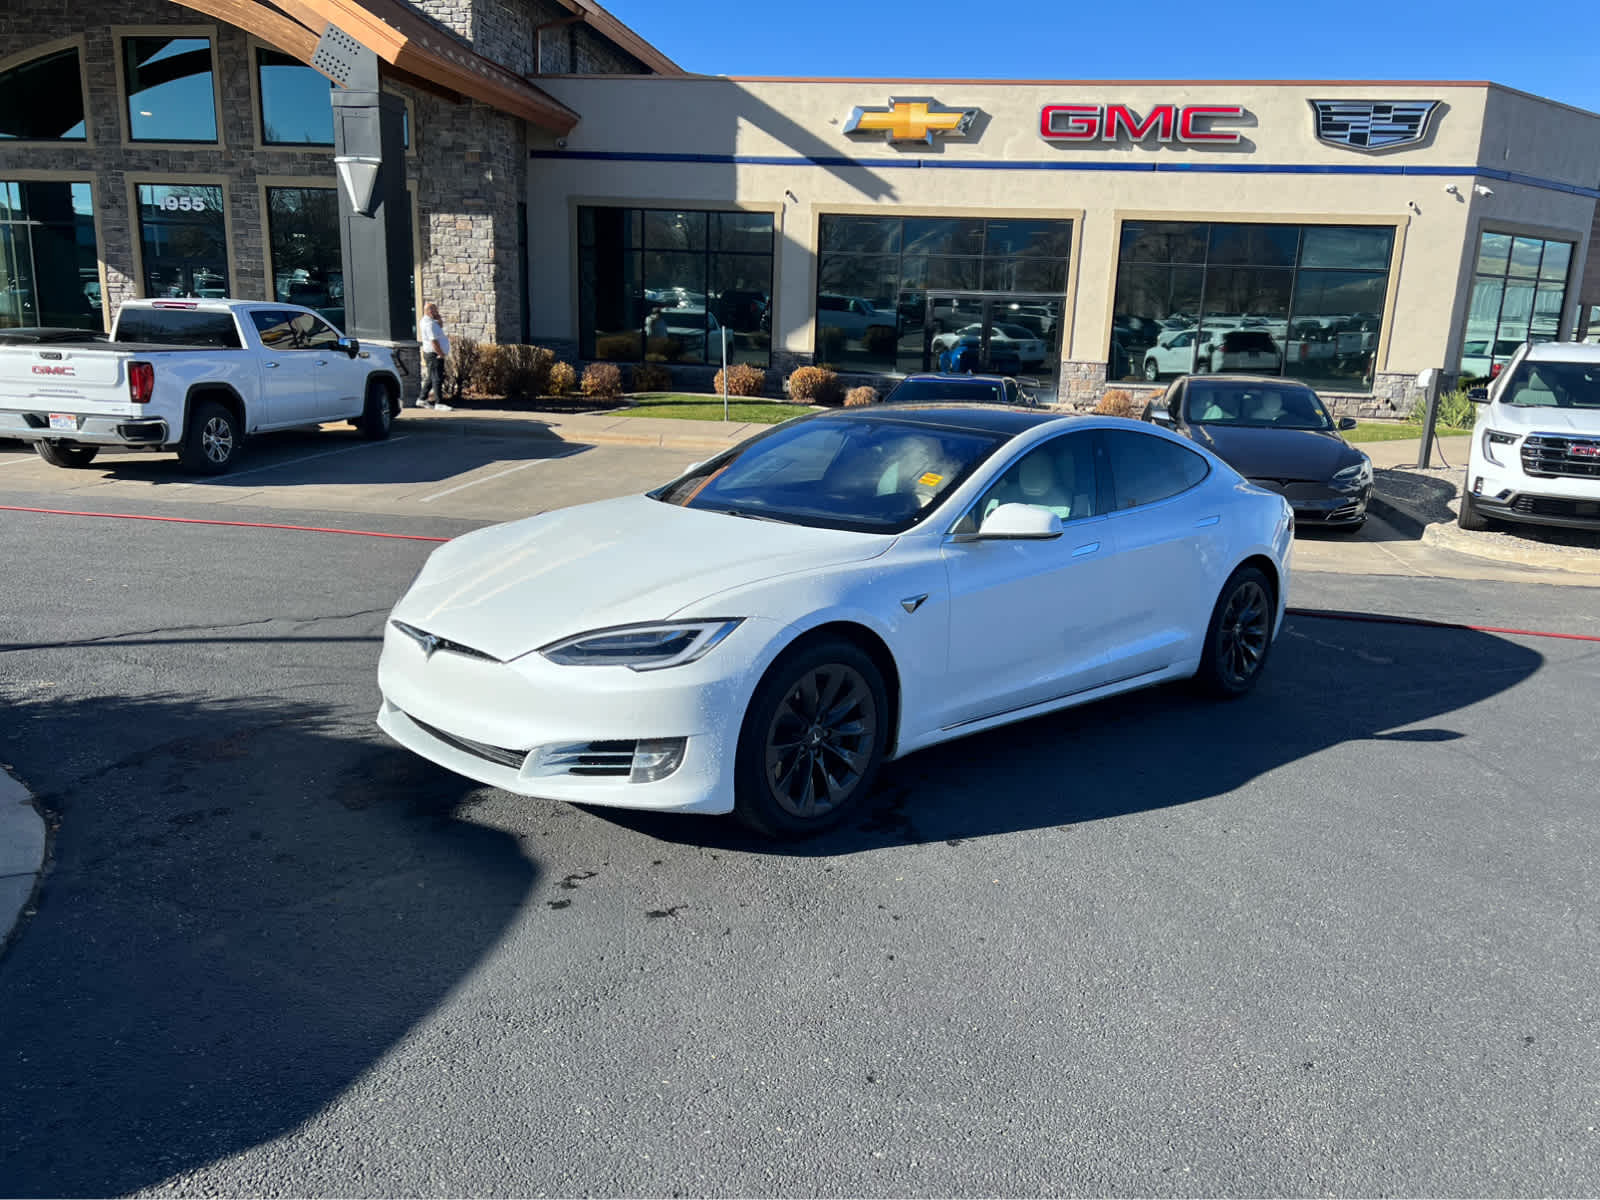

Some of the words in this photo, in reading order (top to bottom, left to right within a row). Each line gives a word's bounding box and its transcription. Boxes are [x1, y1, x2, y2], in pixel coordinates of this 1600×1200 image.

[1039, 104, 1243, 143] GMC
[160, 196, 205, 211] 1955
[32, 365, 75, 376] GMC
